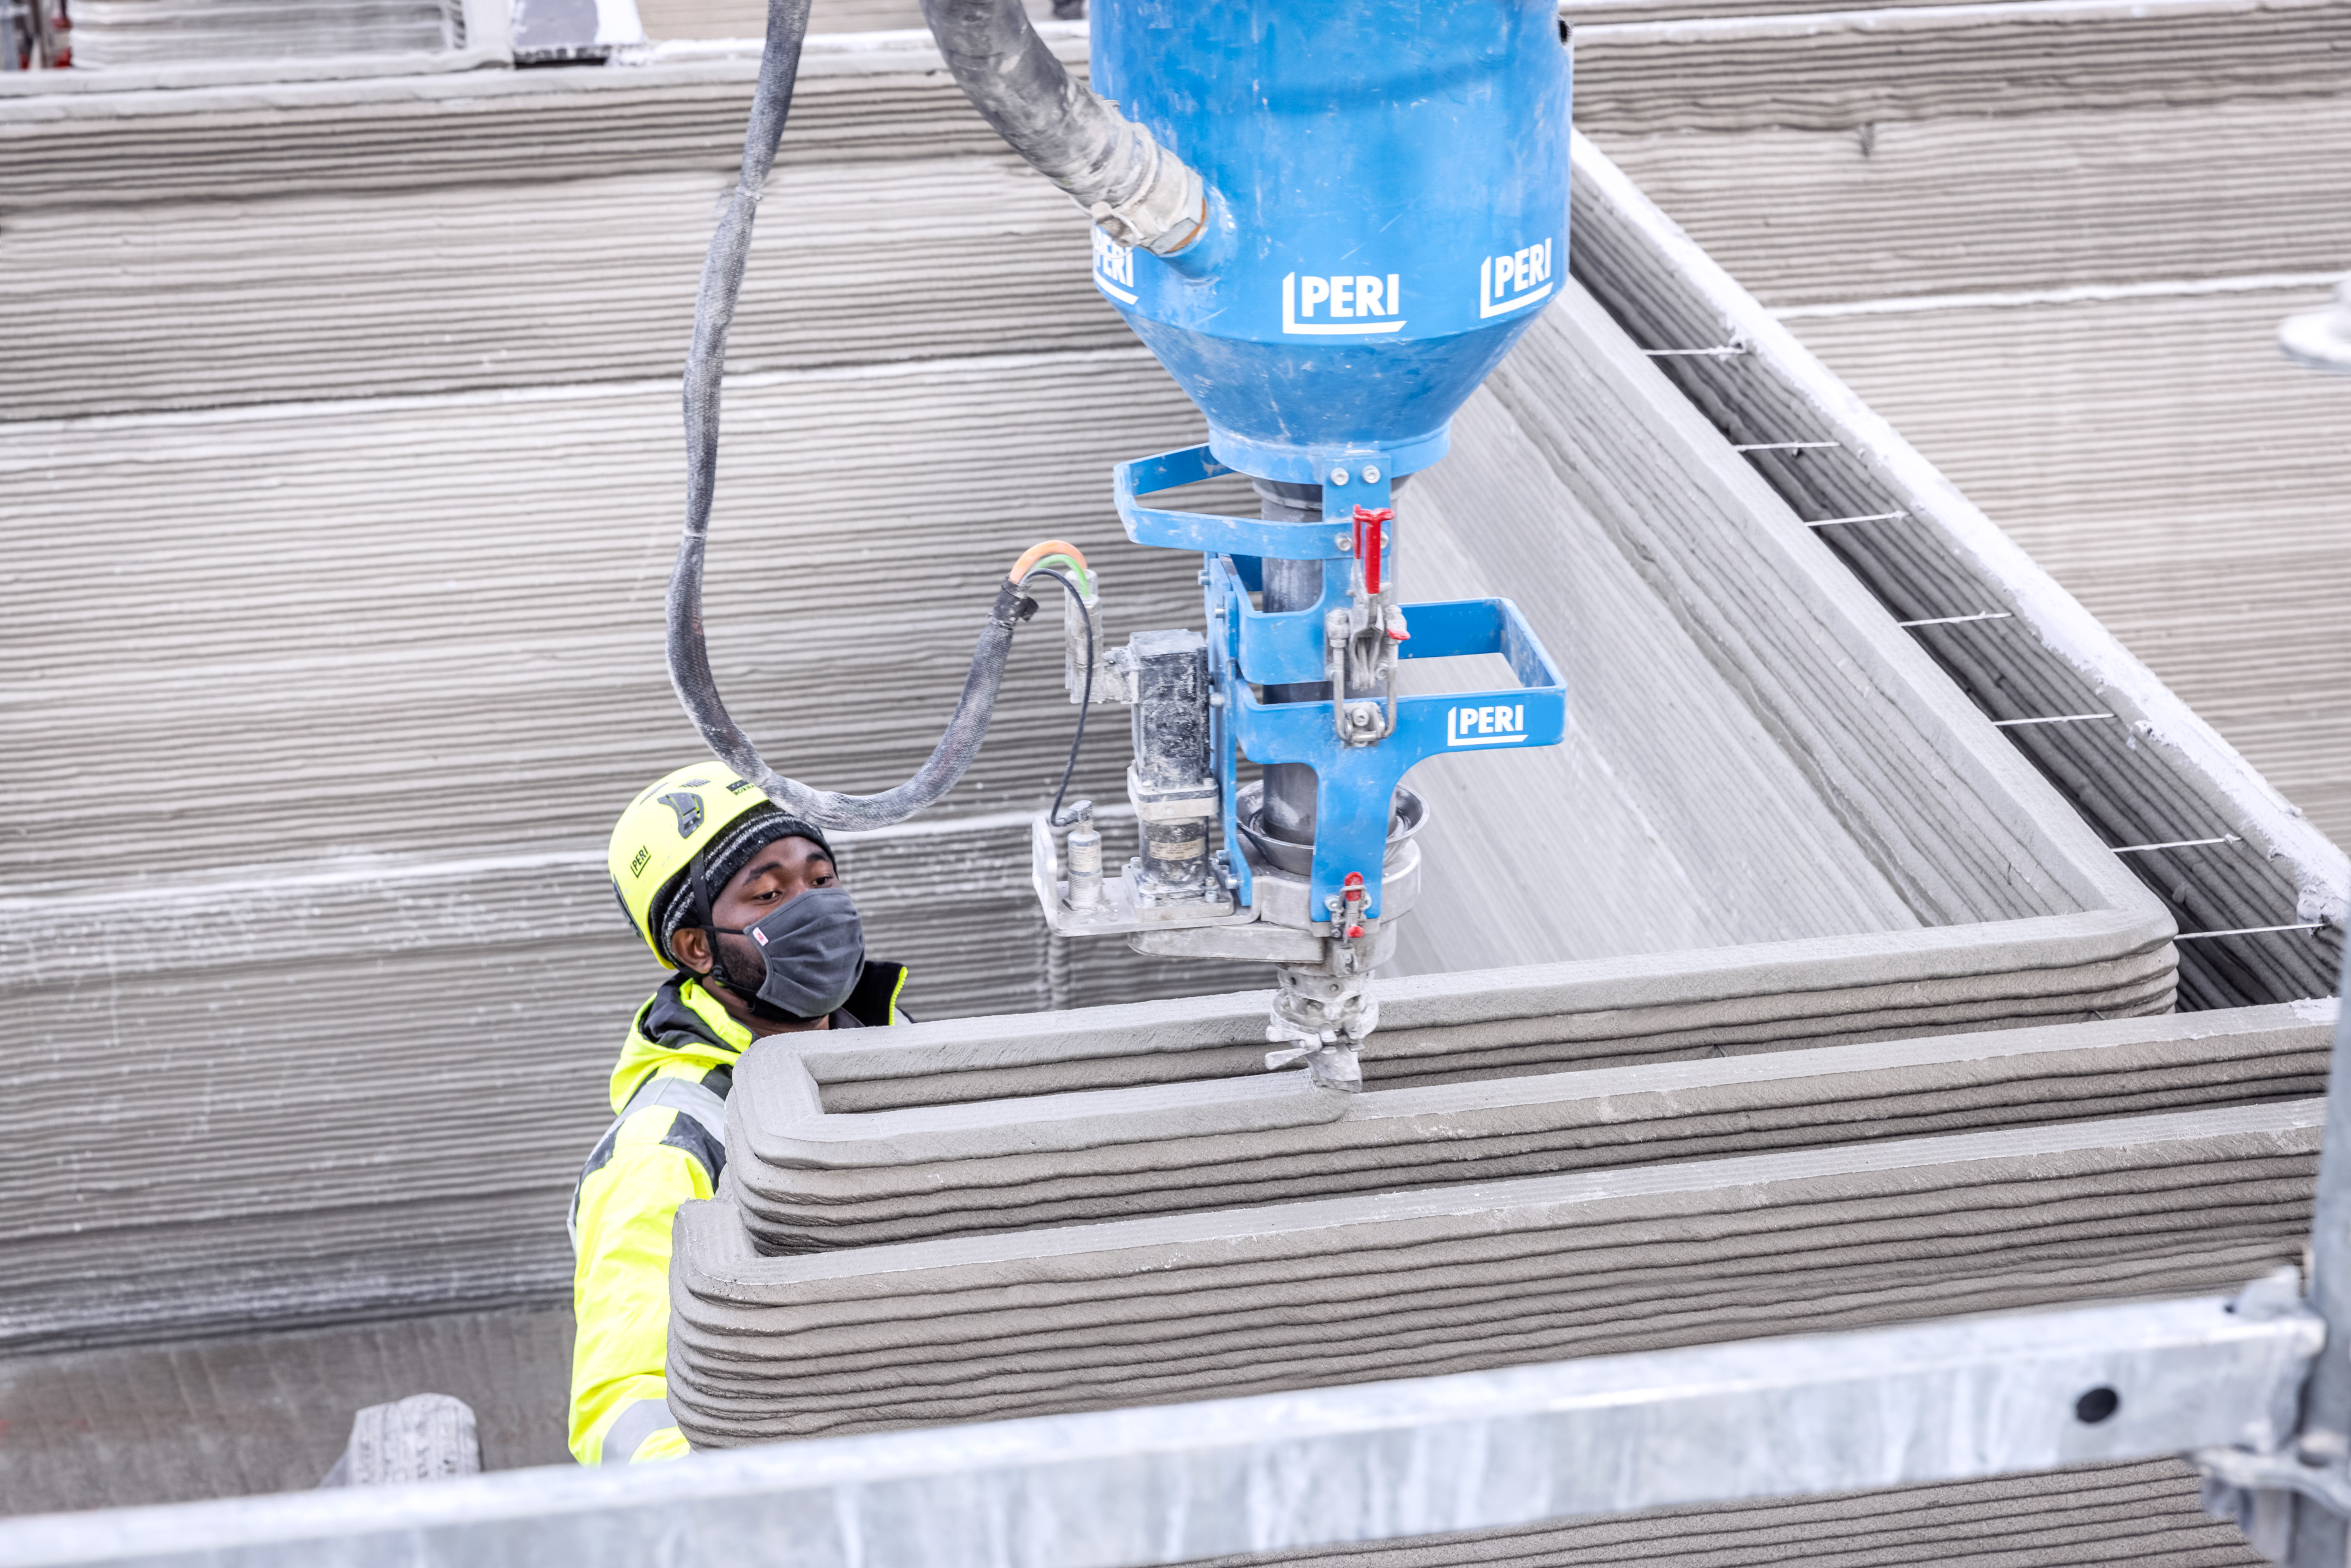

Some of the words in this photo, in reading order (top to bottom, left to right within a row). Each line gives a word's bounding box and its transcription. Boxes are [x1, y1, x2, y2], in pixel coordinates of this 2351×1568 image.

[1494, 237, 1552, 298] PERI
[1301, 273, 1399, 317] PERI
[1459, 704, 1524, 735] PERI
[632, 845, 648, 871] PERI
